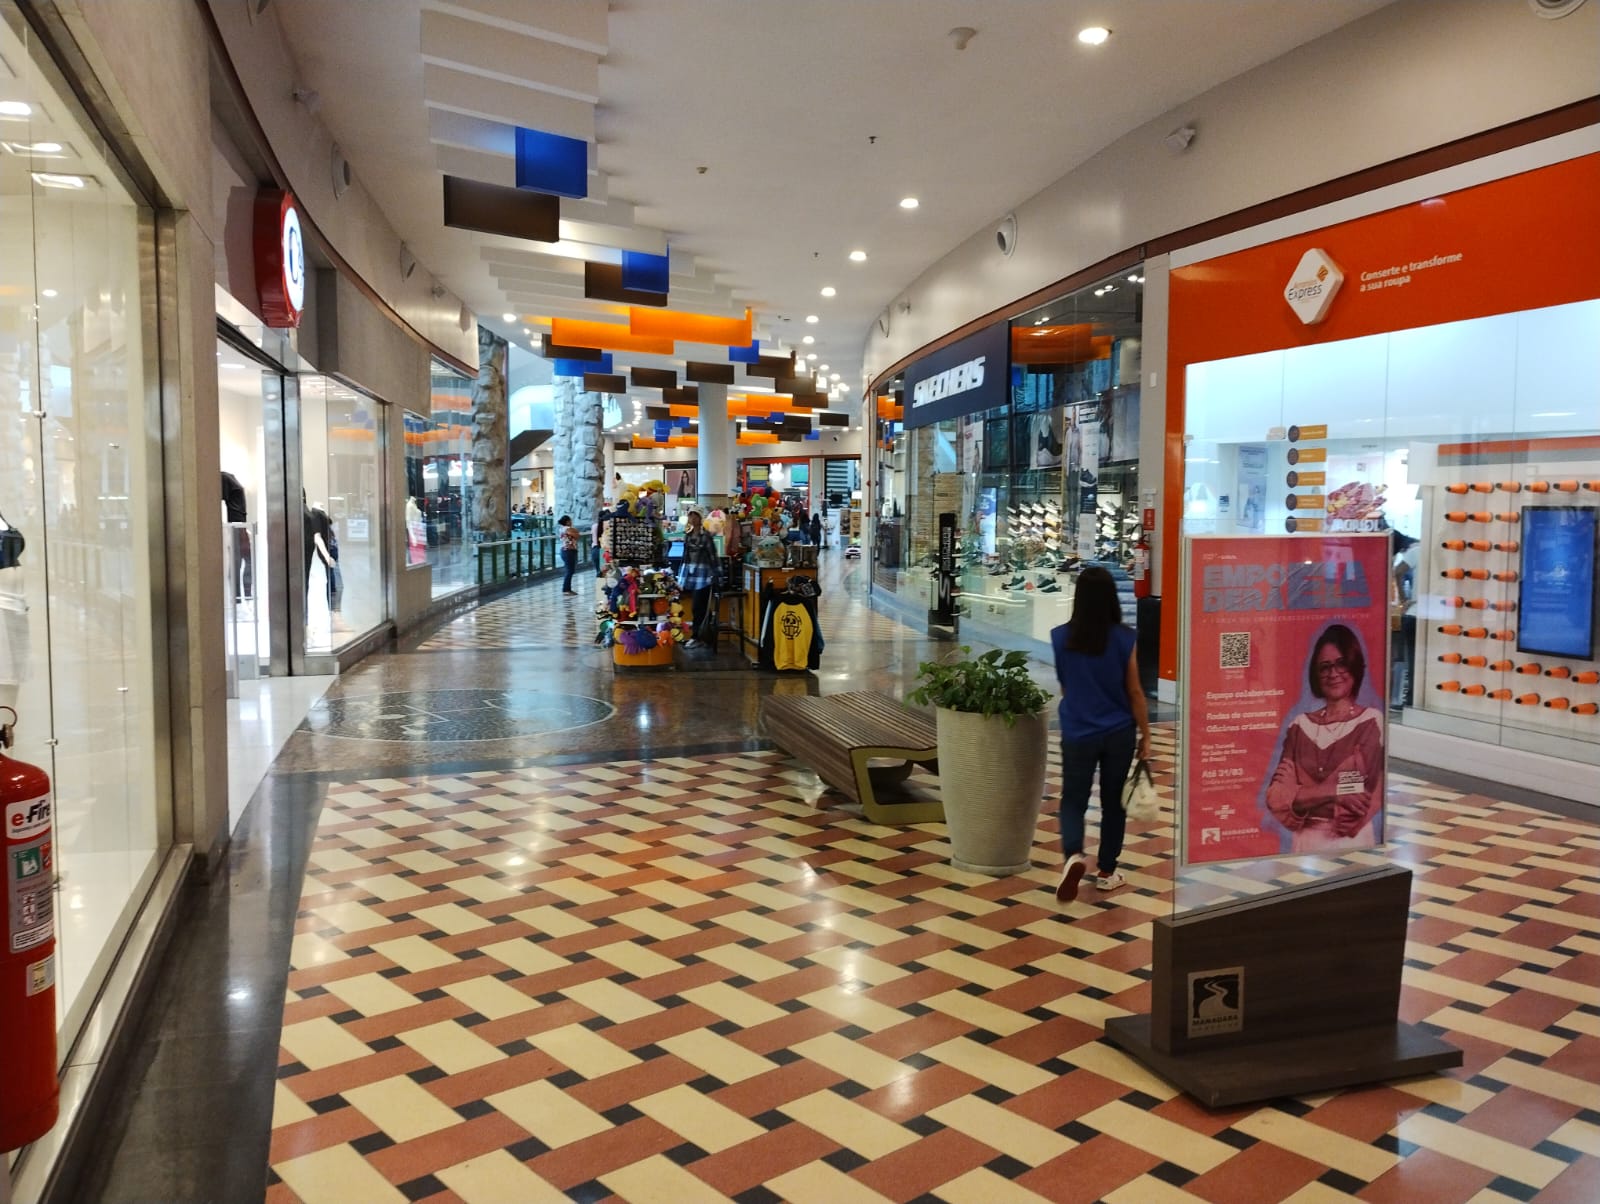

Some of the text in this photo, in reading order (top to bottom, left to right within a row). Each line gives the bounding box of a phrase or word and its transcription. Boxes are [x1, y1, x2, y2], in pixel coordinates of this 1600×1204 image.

[1360, 252, 1463, 282] Conserte e transforme
[1288, 284, 1322, 302] Express
[1360, 275, 1411, 292] a sua roupa
[912, 355, 986, 409] SKECHERS
[1203, 564, 1287, 588] EMPO
